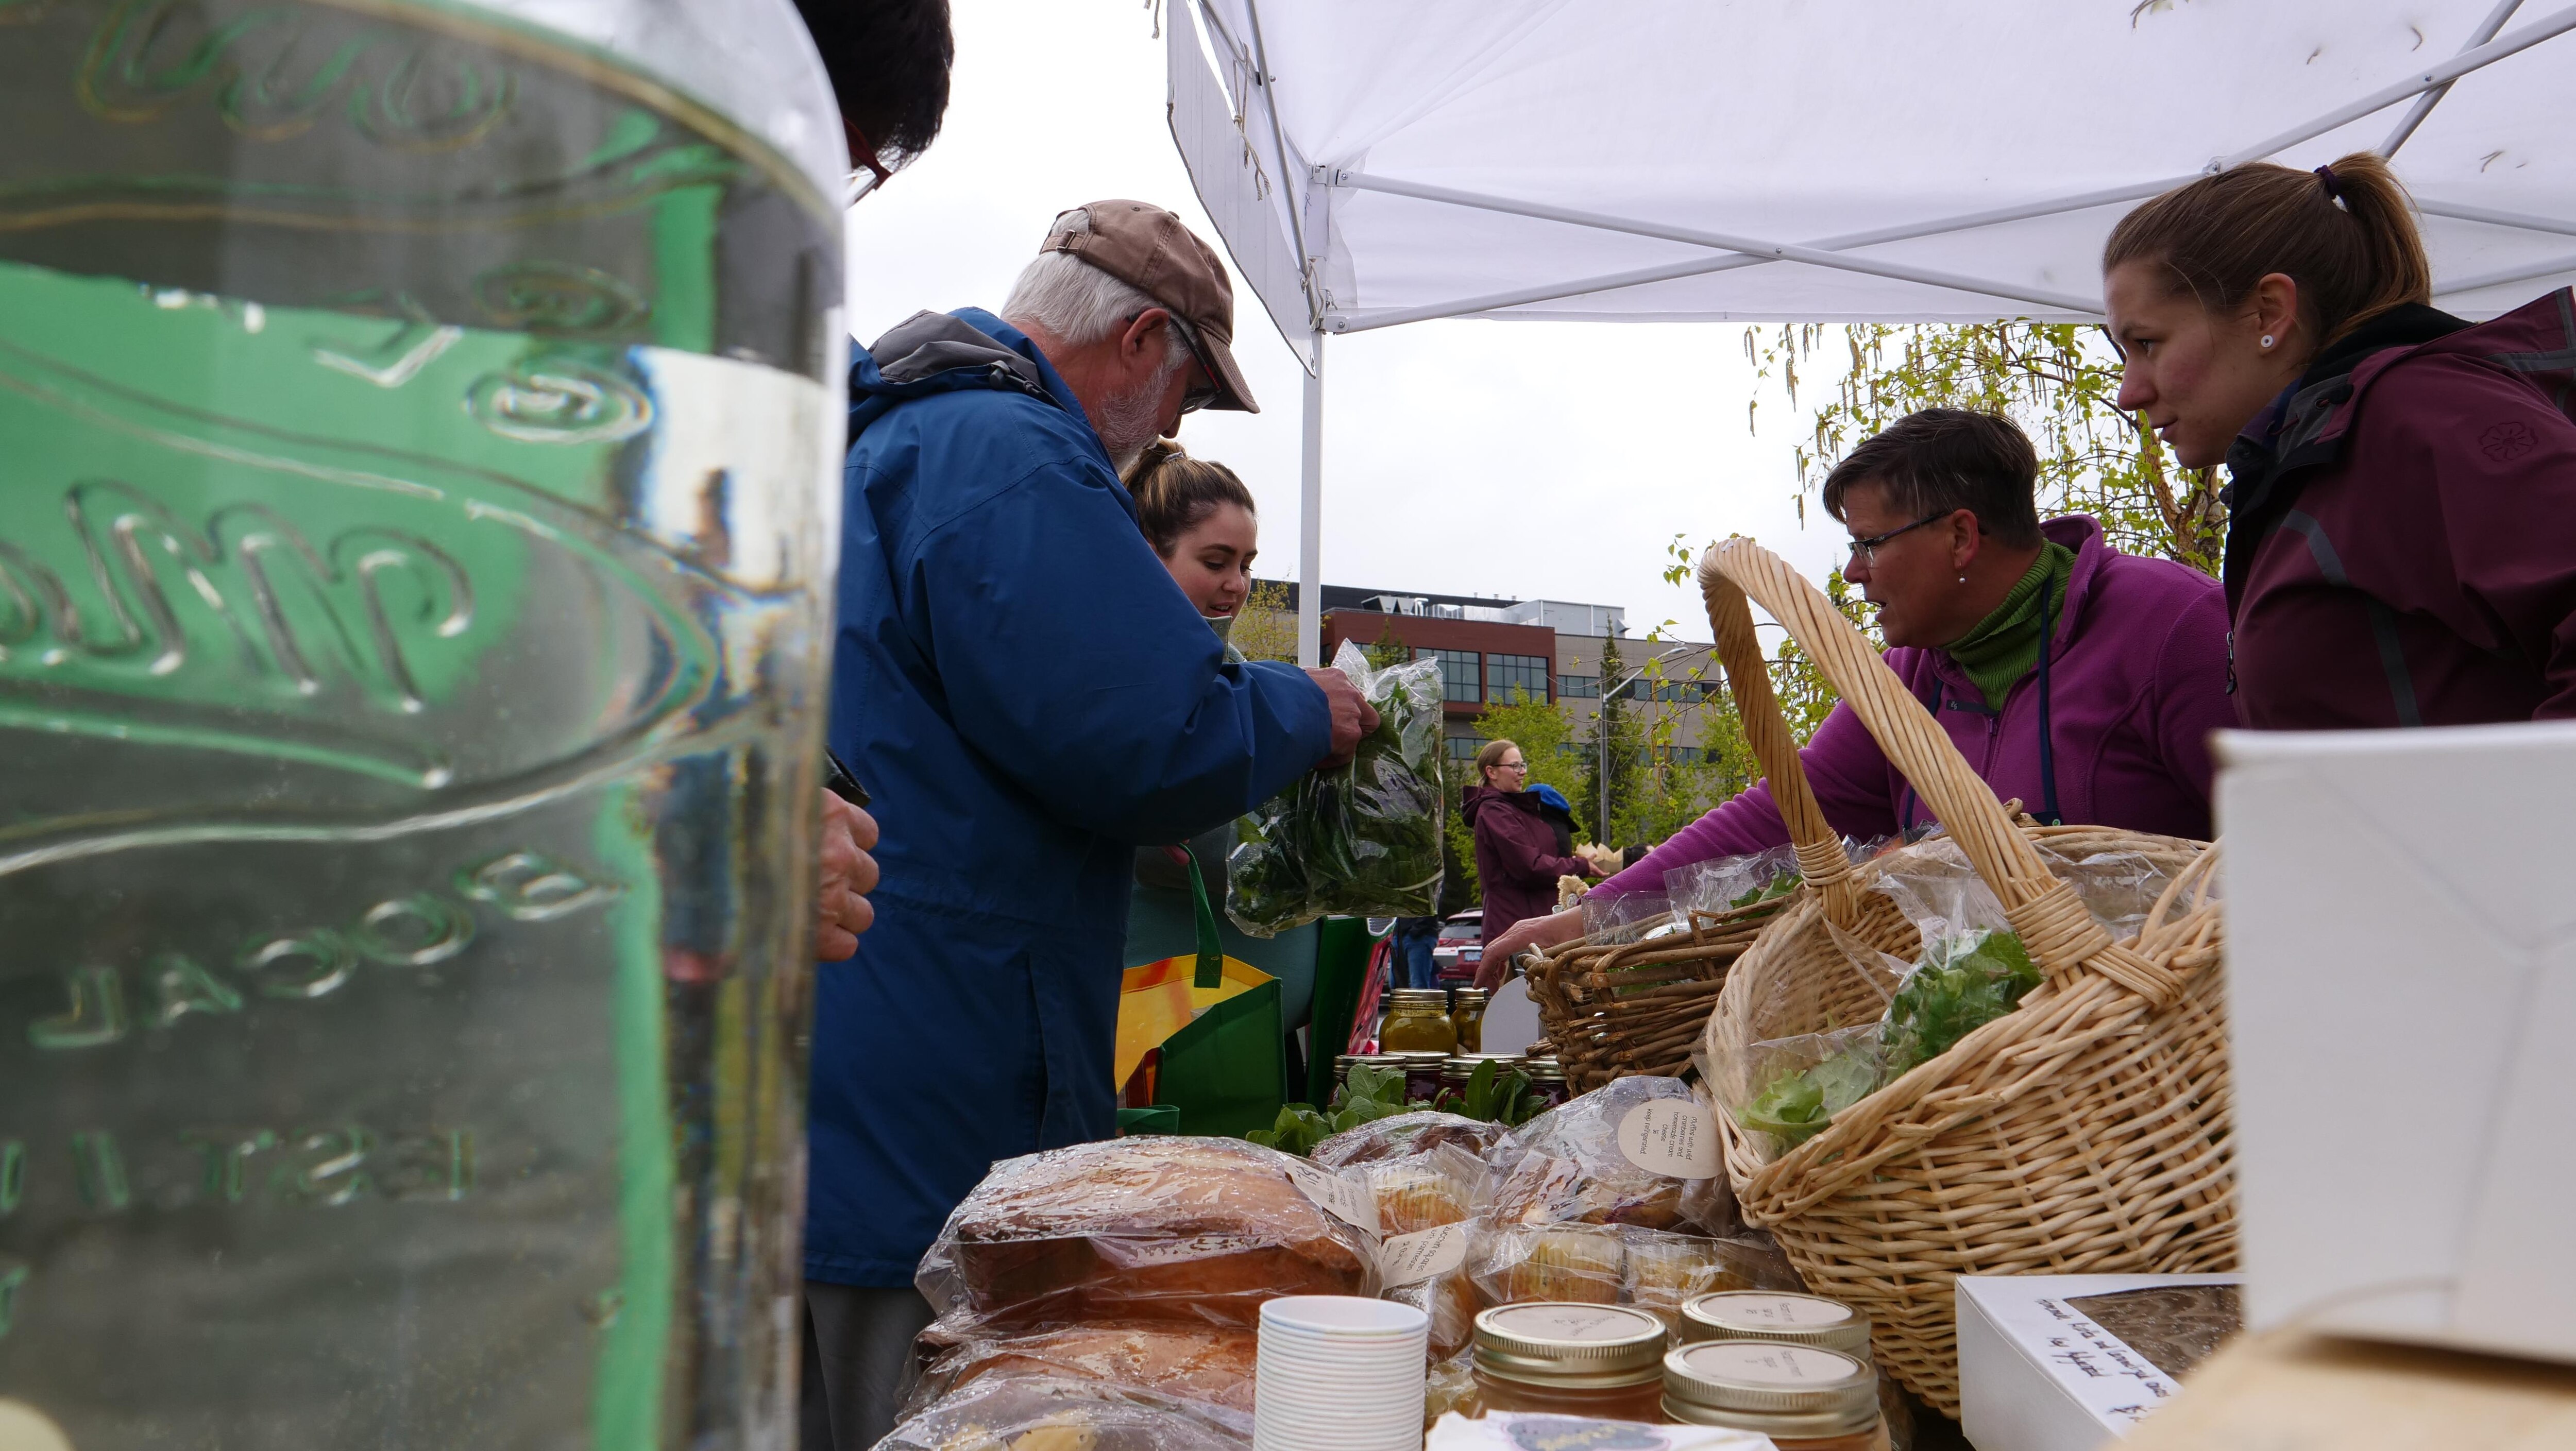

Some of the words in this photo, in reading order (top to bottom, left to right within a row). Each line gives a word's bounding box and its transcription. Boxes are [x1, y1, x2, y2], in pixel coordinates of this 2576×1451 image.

[1640, 1122, 1650, 1154] refrigerated
[1670, 1112, 1680, 1139] homemade
[1679, 1115, 1688, 1146] cranberries
